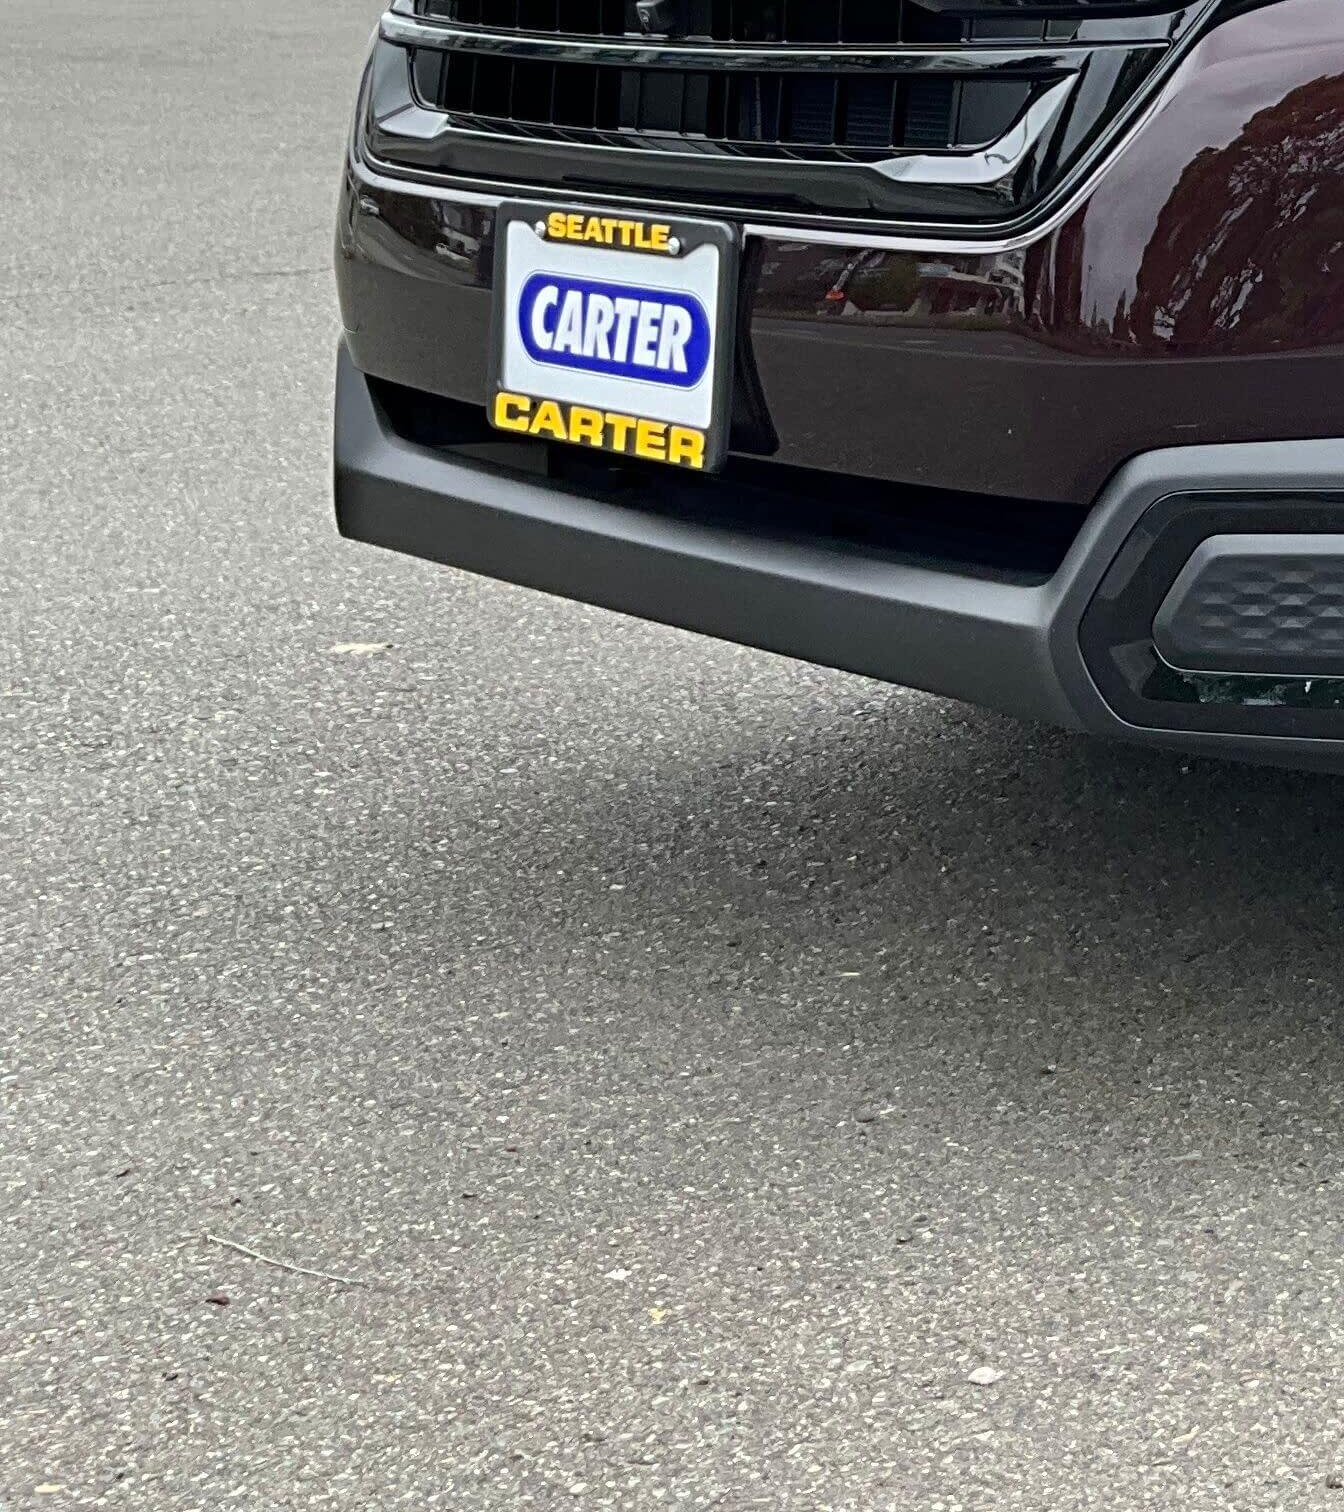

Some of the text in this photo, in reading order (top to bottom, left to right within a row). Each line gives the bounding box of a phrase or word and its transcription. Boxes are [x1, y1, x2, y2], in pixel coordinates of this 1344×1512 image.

[548, 211, 672, 251] SEATTLE
[530, 285, 693, 373] CARTER
[494, 391, 706, 469] CARTER
